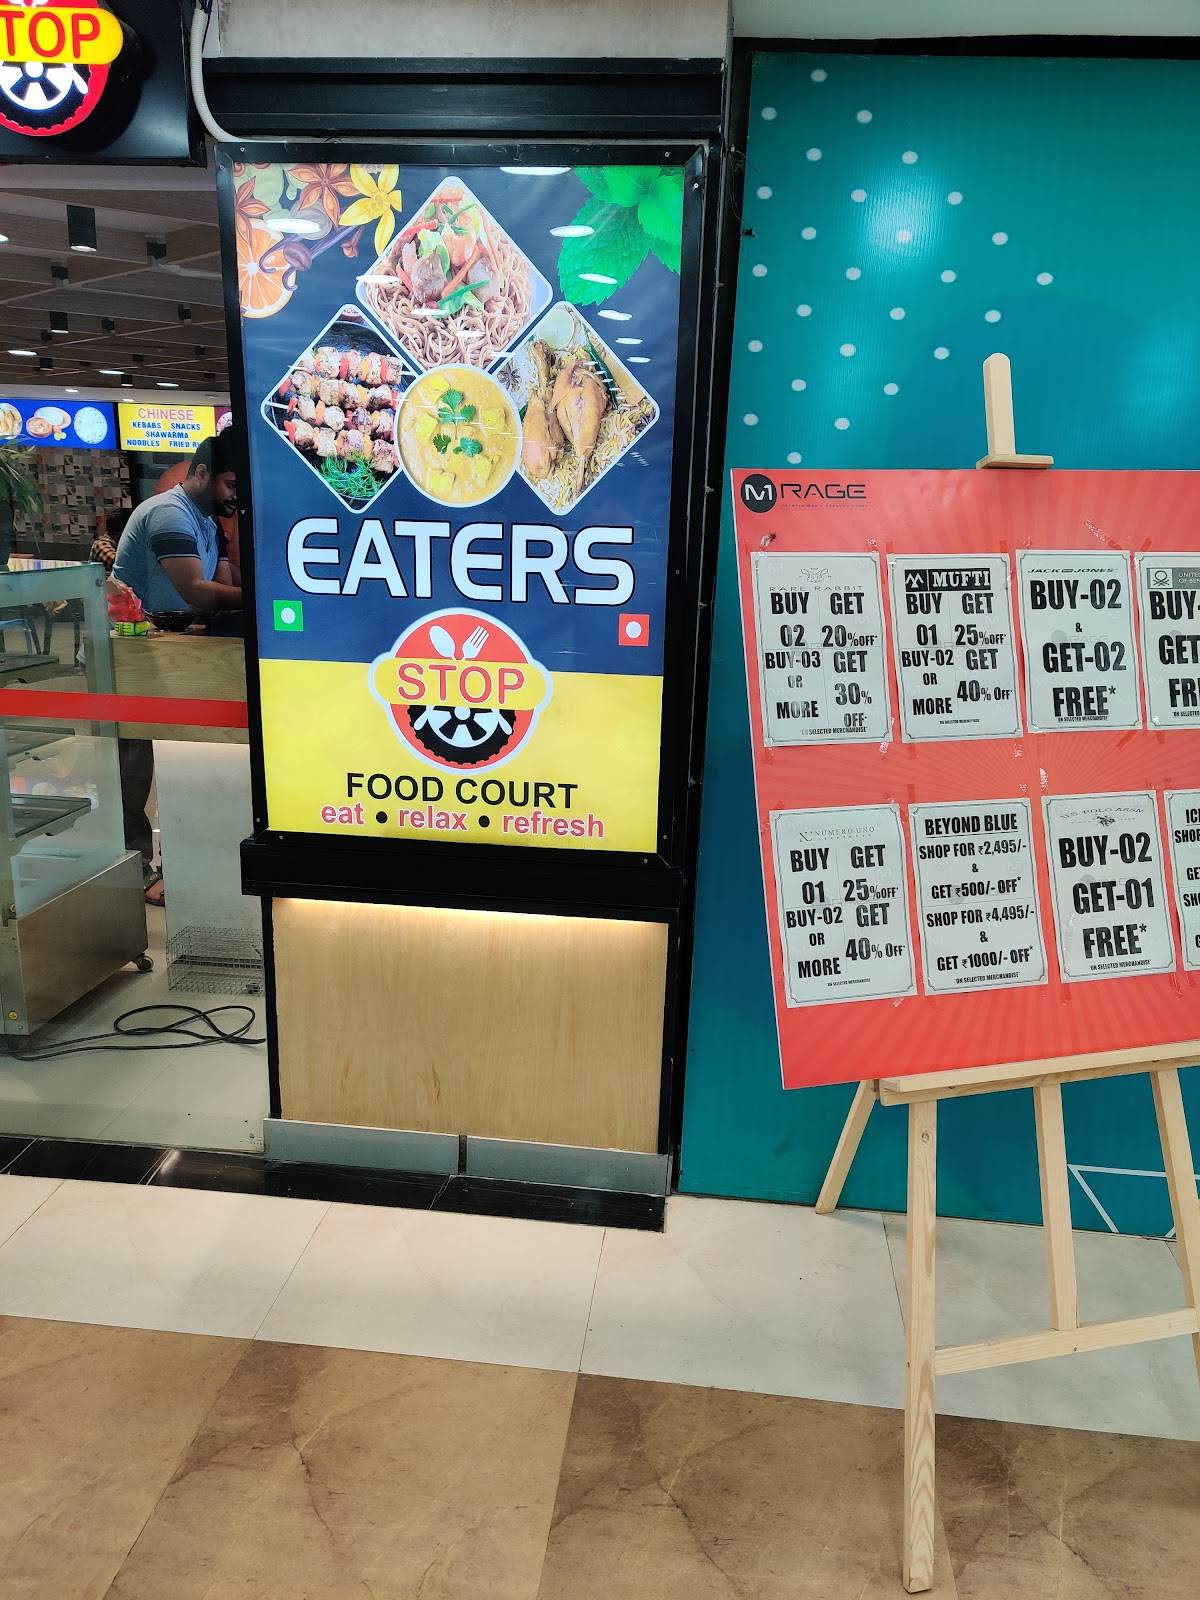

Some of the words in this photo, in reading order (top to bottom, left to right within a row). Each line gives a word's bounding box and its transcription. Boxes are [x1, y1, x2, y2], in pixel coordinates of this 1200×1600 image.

[137, 408, 194, 420] CHINESE
[132, 421, 161, 429] KEBABS
[170, 422, 201, 430] SNACKS
[145, 431, 189, 439] SHAWARMA
[126, 439, 160, 447] NOODLES
[169, 440, 190, 448] FRIED
[285, 517, 636, 606] EATERS
[932, 570, 991, 588] MUFTI
[770, 592, 810, 615] BUY
[830, 592, 865, 615] GET
[906, 592, 942, 615] BUY
[961, 592, 994, 614] GET
[1030, 579, 1122, 610] BUY-02
[1148, 590, 1200, 620] BUY
[780, 624, 806, 647] 02
[916, 624, 938, 646] 01
[1075, 622, 1083, 633] &
[765, 650, 821, 669] BUY-03
[833, 650, 868, 673] GET
[901, 649, 954, 668] BUY-02
[965, 649, 999, 670] GET
[1042, 641, 1127, 673] GET-02
[397, 662, 525, 704] STOP
[787, 675, 803, 688] OR
[922, 673, 938, 686] OR
[956, 680, 992, 702] 40%
[1168, 677, 1200, 707] FR
[834, 682, 872, 706] 30%
[776, 701, 819, 719] MORE
[912, 697, 953, 716] MORE
[346, 772, 444, 802] FOOD
[455, 777, 579, 809] COURT
[320, 802, 365, 826] eat
[398, 805, 469, 831] relax
[502, 809, 606, 839] refresh
[855, 826, 875, 834] UNO
[924, 815, 981, 836] BEYOND
[983, 813, 1018, 832] BLUE
[789, 847, 830, 873] BUY
[850, 844, 886, 869] GET
[919, 844, 951, 860] SHOP
[953, 842, 976, 857] FOR
[1058, 832, 1153, 869] BUY-02
[971, 863, 979, 873] &
[1186, 866, 1200, 881] GE
[801, 880, 826, 905] 01
[931, 884, 952, 900] GET
[1072, 877, 1155, 915] GET-01
[785, 906, 843, 929] BUY-02
[855, 903, 890, 927] GET
[926, 911, 958, 928] SHOP
[961, 909, 983, 924] FOR
[808, 932, 825, 947] OR
[845, 937, 883, 961] 40%
[979, 931, 989, 943] &
[797, 957, 842, 979] MORE
[937, 955, 959, 971] GET
[963, 975, 986, 983] SELECTED
